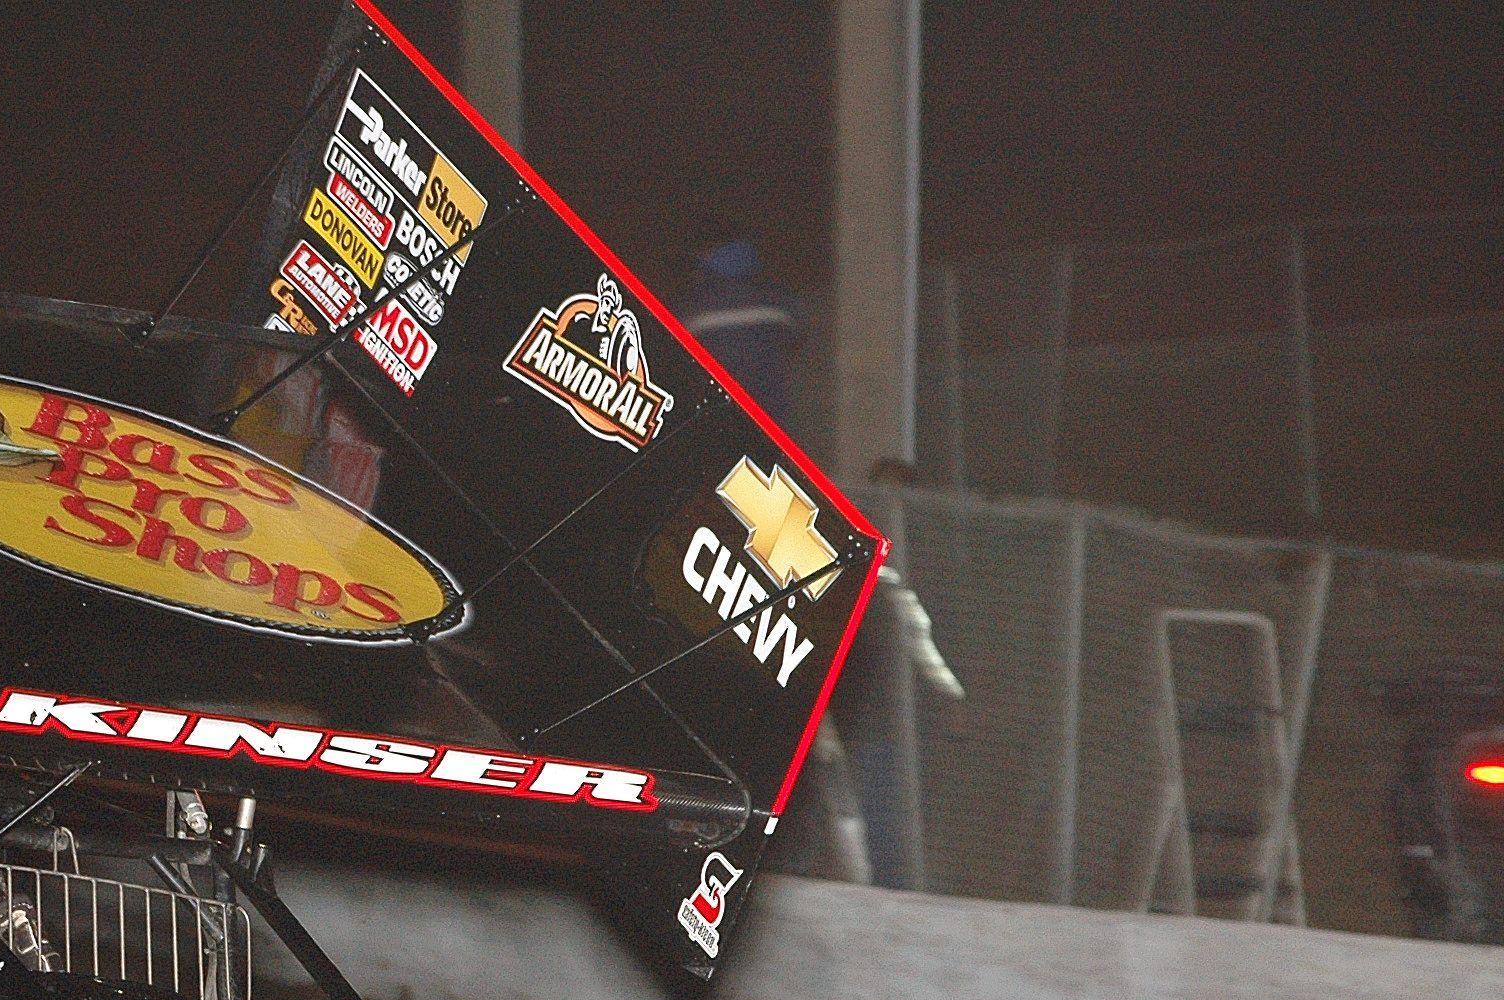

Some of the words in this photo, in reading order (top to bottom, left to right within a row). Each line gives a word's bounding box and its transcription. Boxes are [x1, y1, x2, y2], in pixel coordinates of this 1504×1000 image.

[329, 146, 388, 214] LINCOLN
[360, 105, 427, 196] Parker
[425, 176, 473, 238] Store
[309, 197, 381, 282] DONOVAN
[335, 182, 385, 239] WELDERS
[296, 250, 352, 310] LANE
[387, 255, 444, 322] COETIC
[358, 326, 416, 393] IGNITION
[369, 303, 430, 371] MSD
[20, 392, 298, 507] Bass
[34, 441, 251, 536] Pro
[44, 493, 404, 625] Shops
[682, 526, 815, 689] CHEVY
